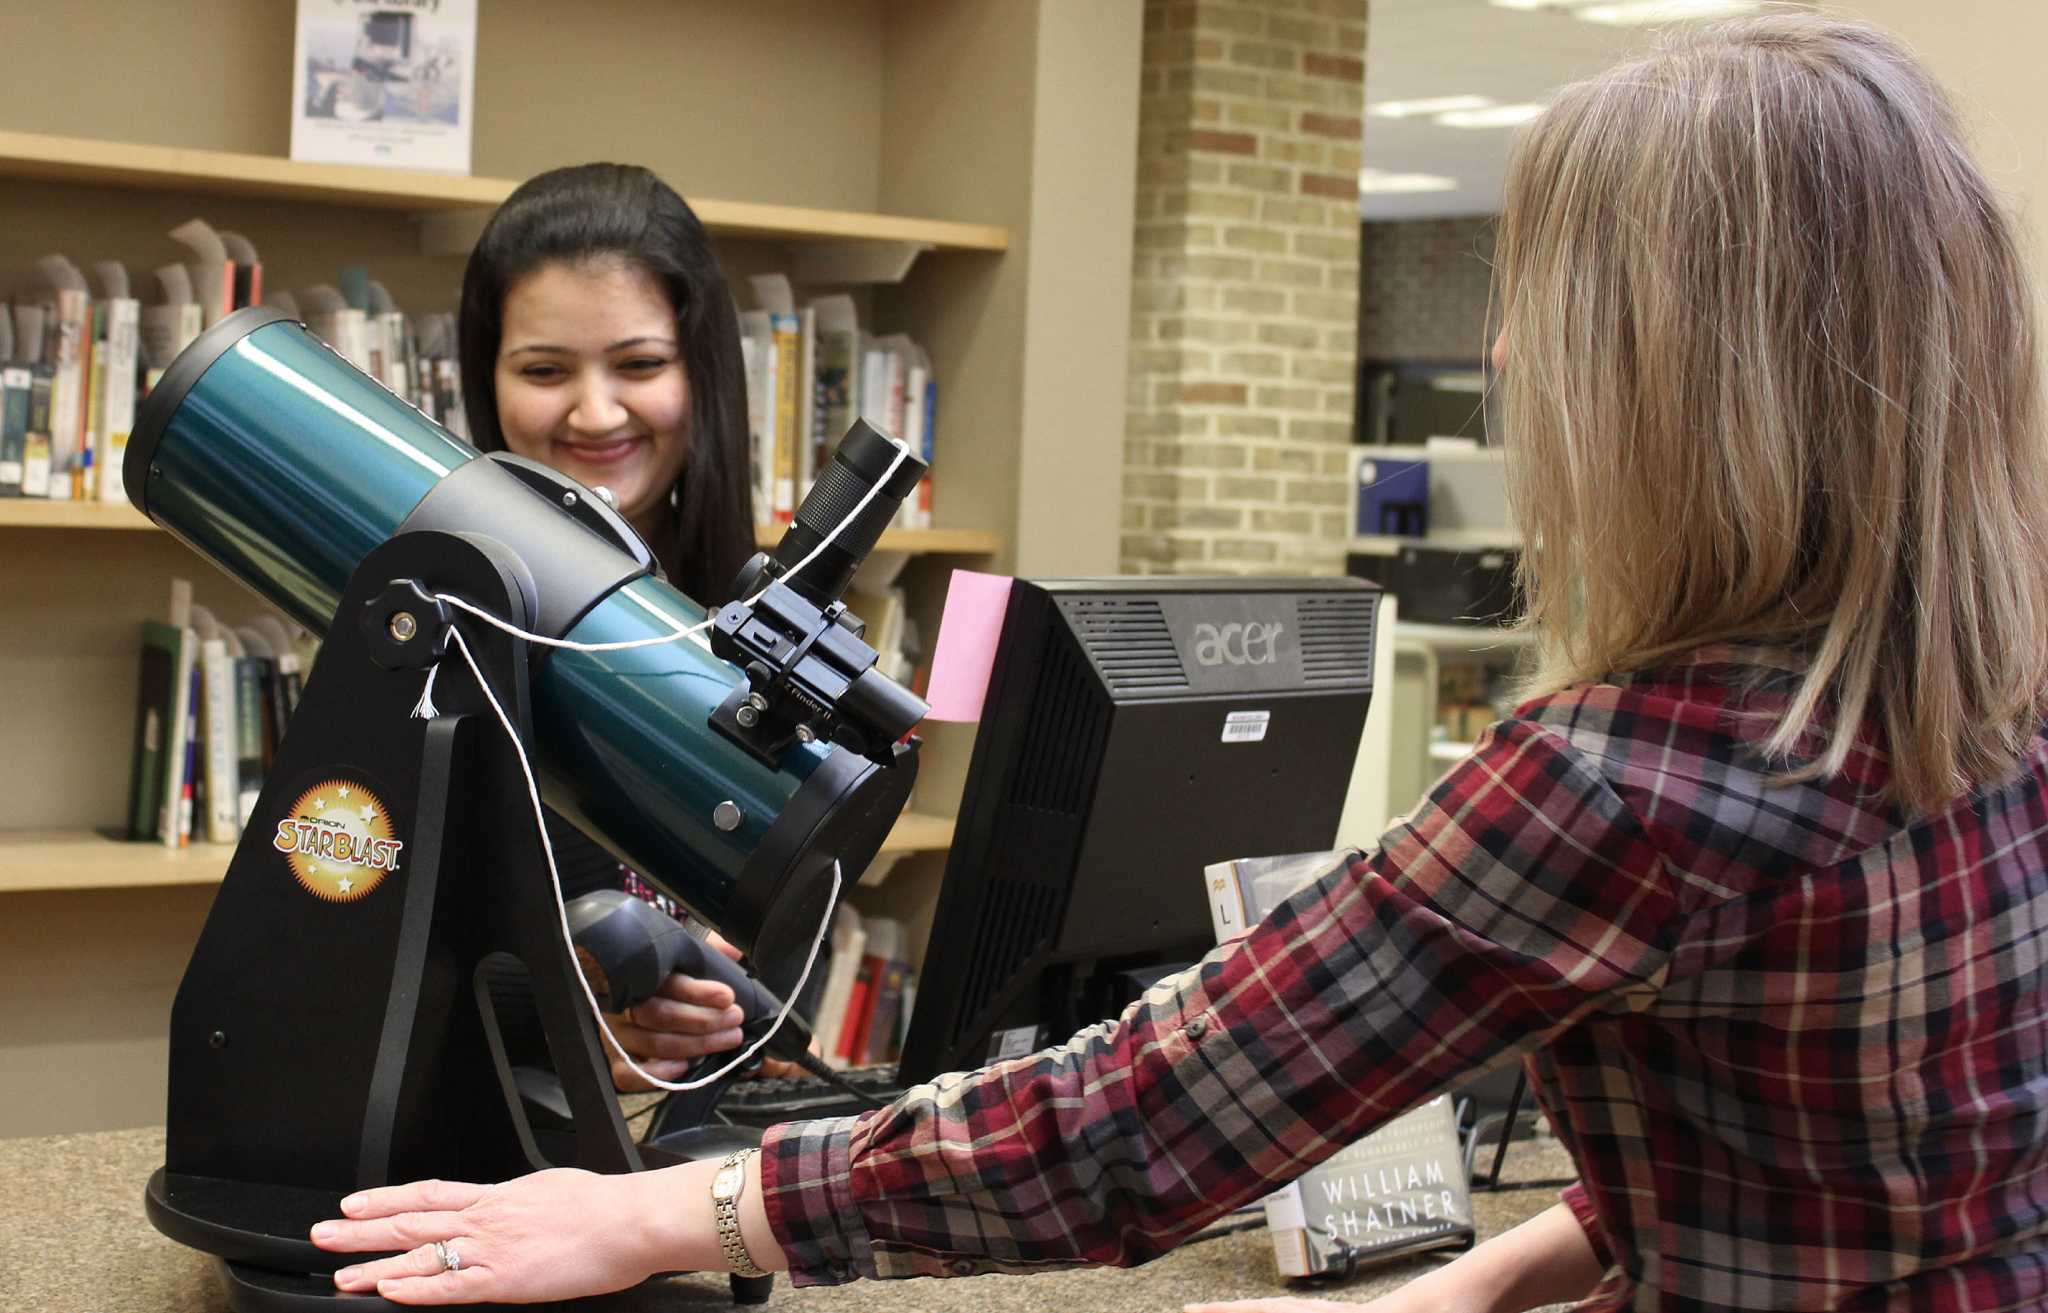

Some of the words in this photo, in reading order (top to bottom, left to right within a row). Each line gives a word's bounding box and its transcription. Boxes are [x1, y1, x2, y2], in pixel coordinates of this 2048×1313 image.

[1194, 621, 1284, 666] acer
[1321, 1160, 1445, 1206] WILLIAM
[1325, 1190, 1456, 1240] SHATNER
